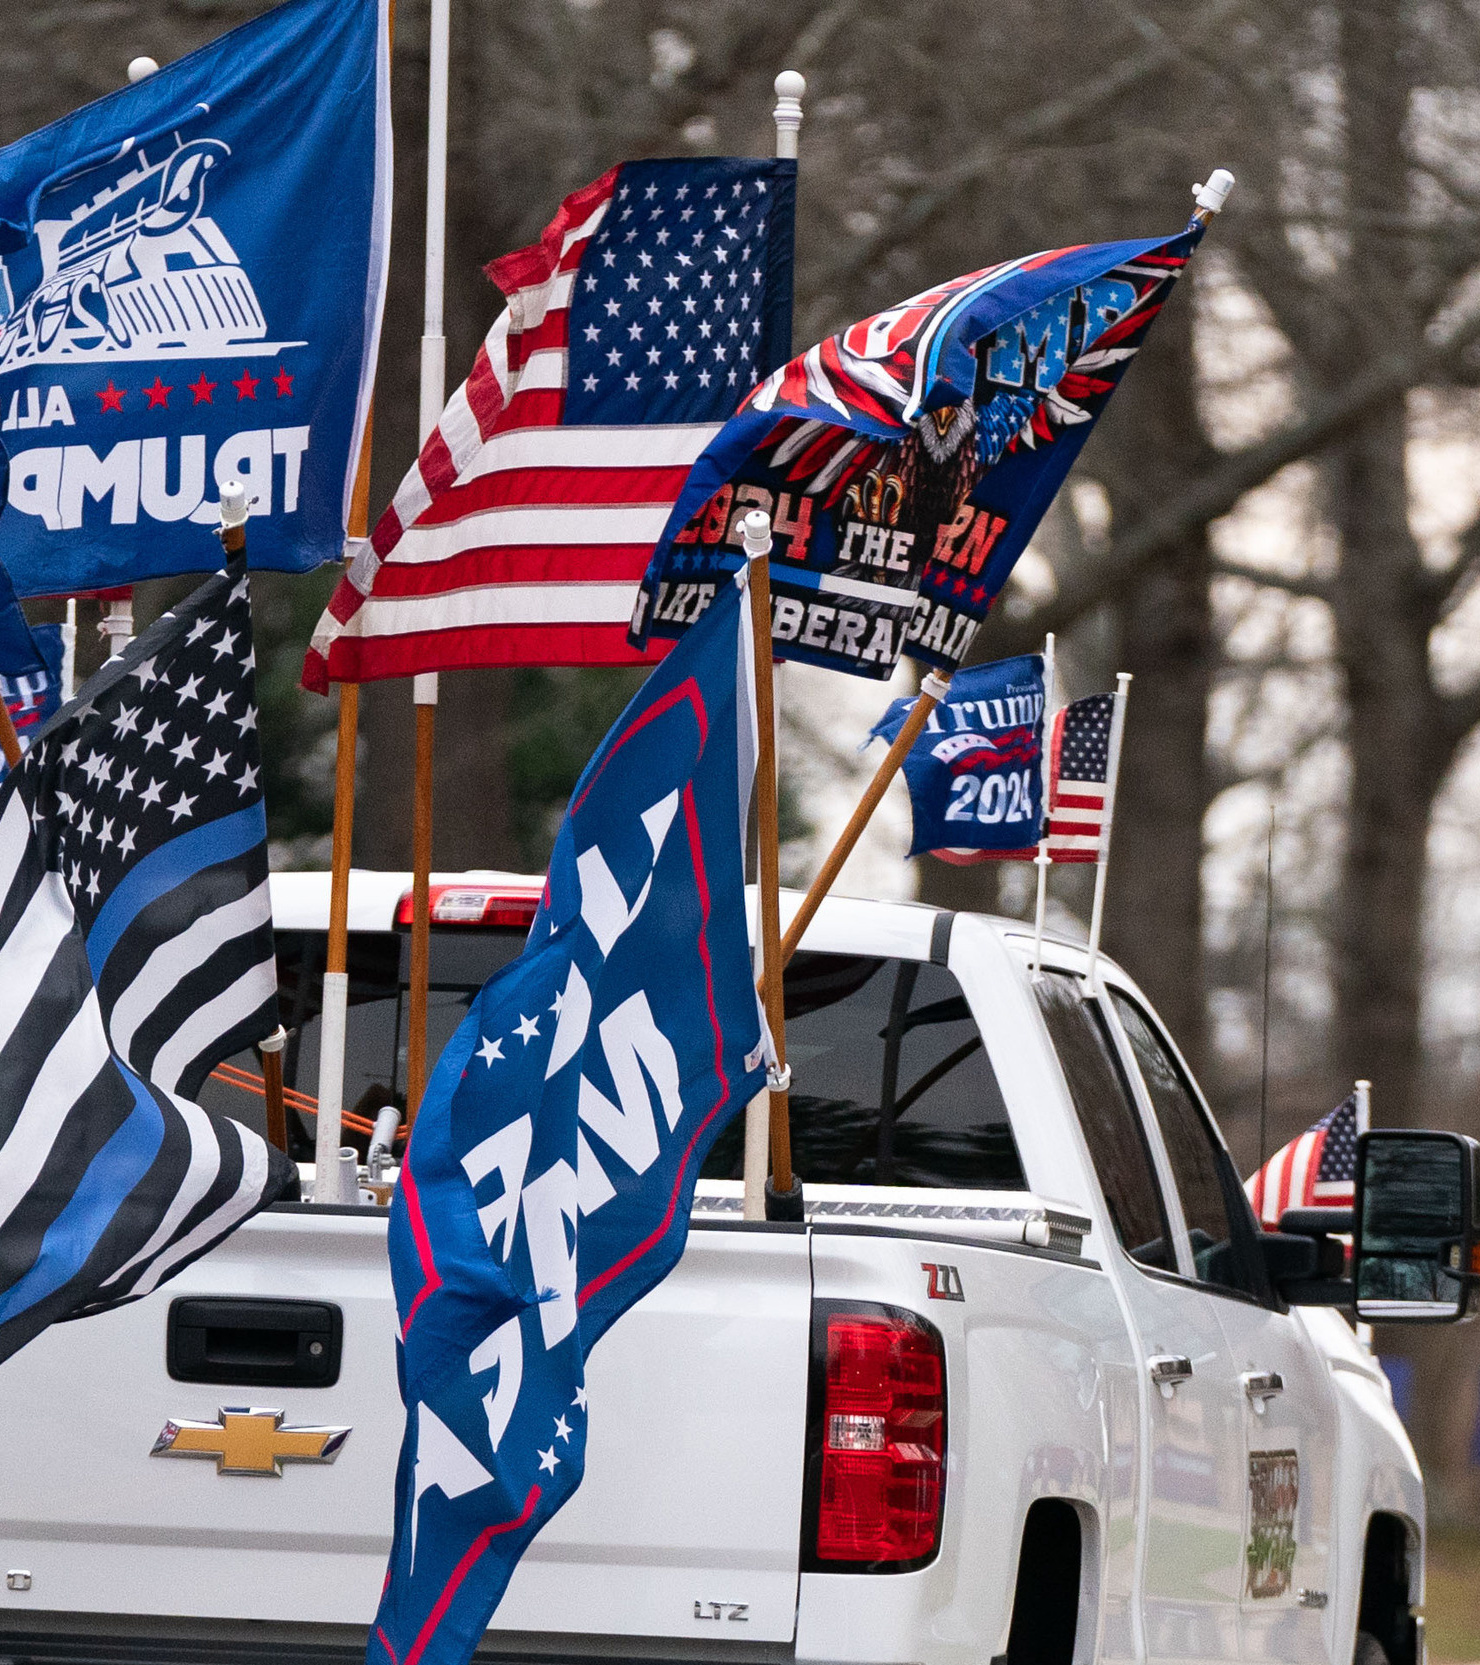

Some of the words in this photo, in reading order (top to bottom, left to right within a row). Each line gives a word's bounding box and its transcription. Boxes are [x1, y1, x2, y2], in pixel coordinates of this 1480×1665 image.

[838, 521, 916, 574] THE
[906, 595, 982, 662] GAIN
[945, 769, 1032, 824] 2024
[694, 1601, 749, 1621] LTZ
